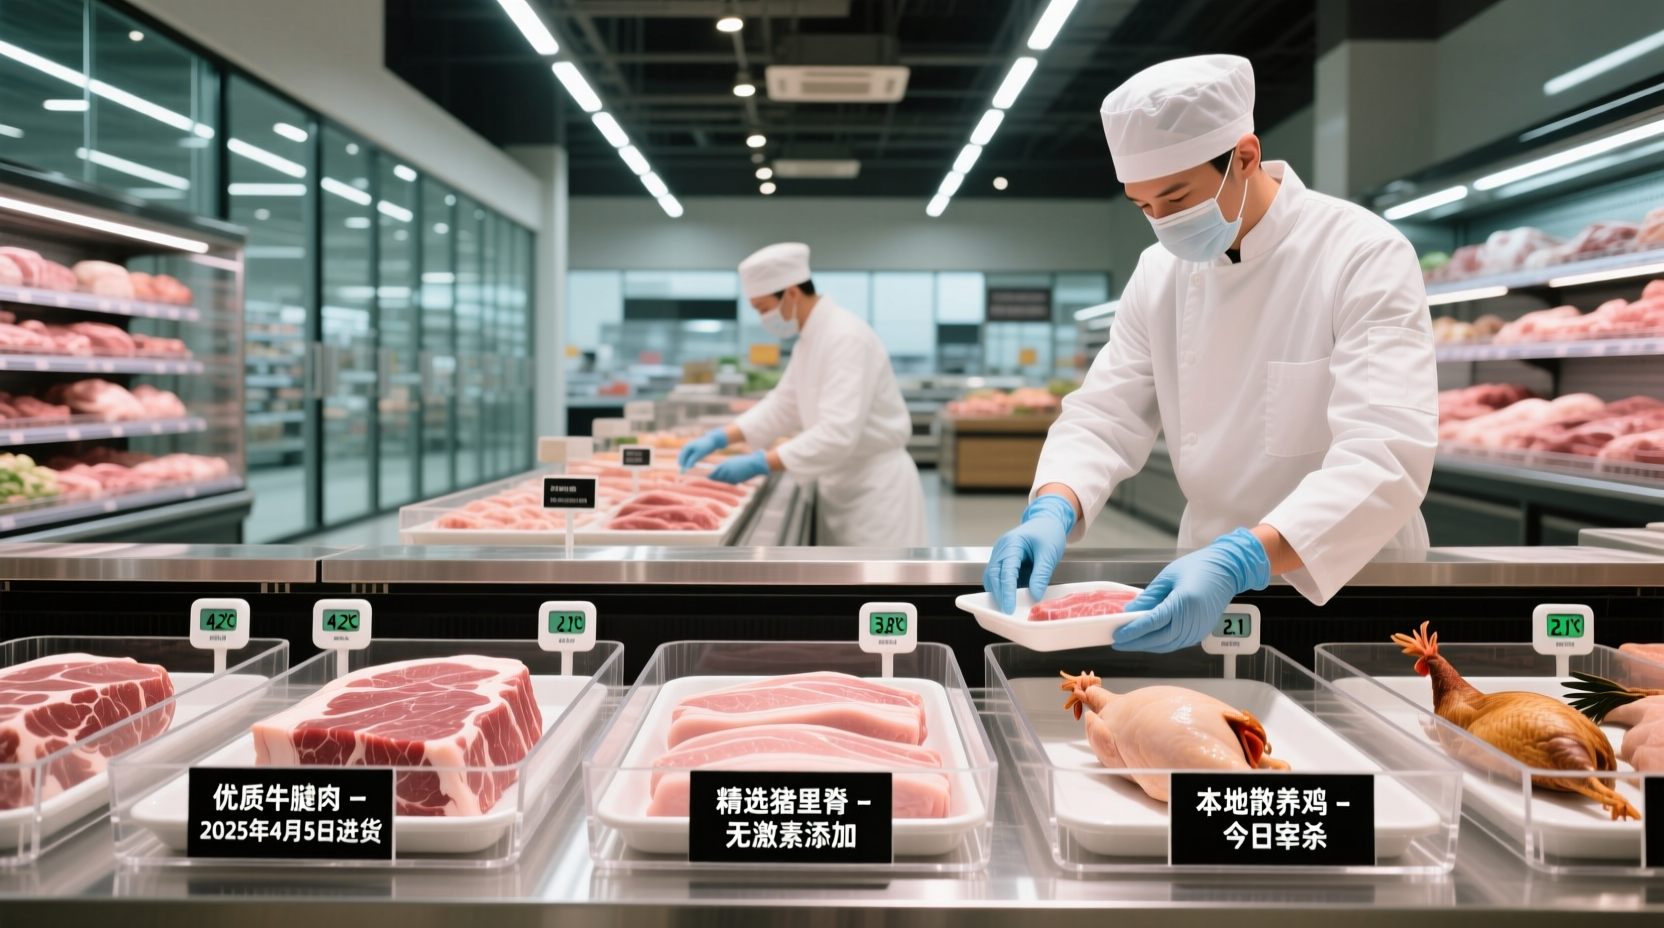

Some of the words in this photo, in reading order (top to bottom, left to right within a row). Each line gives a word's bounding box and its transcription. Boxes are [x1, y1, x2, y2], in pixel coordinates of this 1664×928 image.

[716, 786, 849, 815] 精选猪里脊
[1196, 787, 1328, 816] 本地散养鸡
[199, 817, 382, 844] 2025年4月5日进货
[726, 820, 857, 849] 无激素添加
[1223, 821, 1327, 850] 今日宰杀
